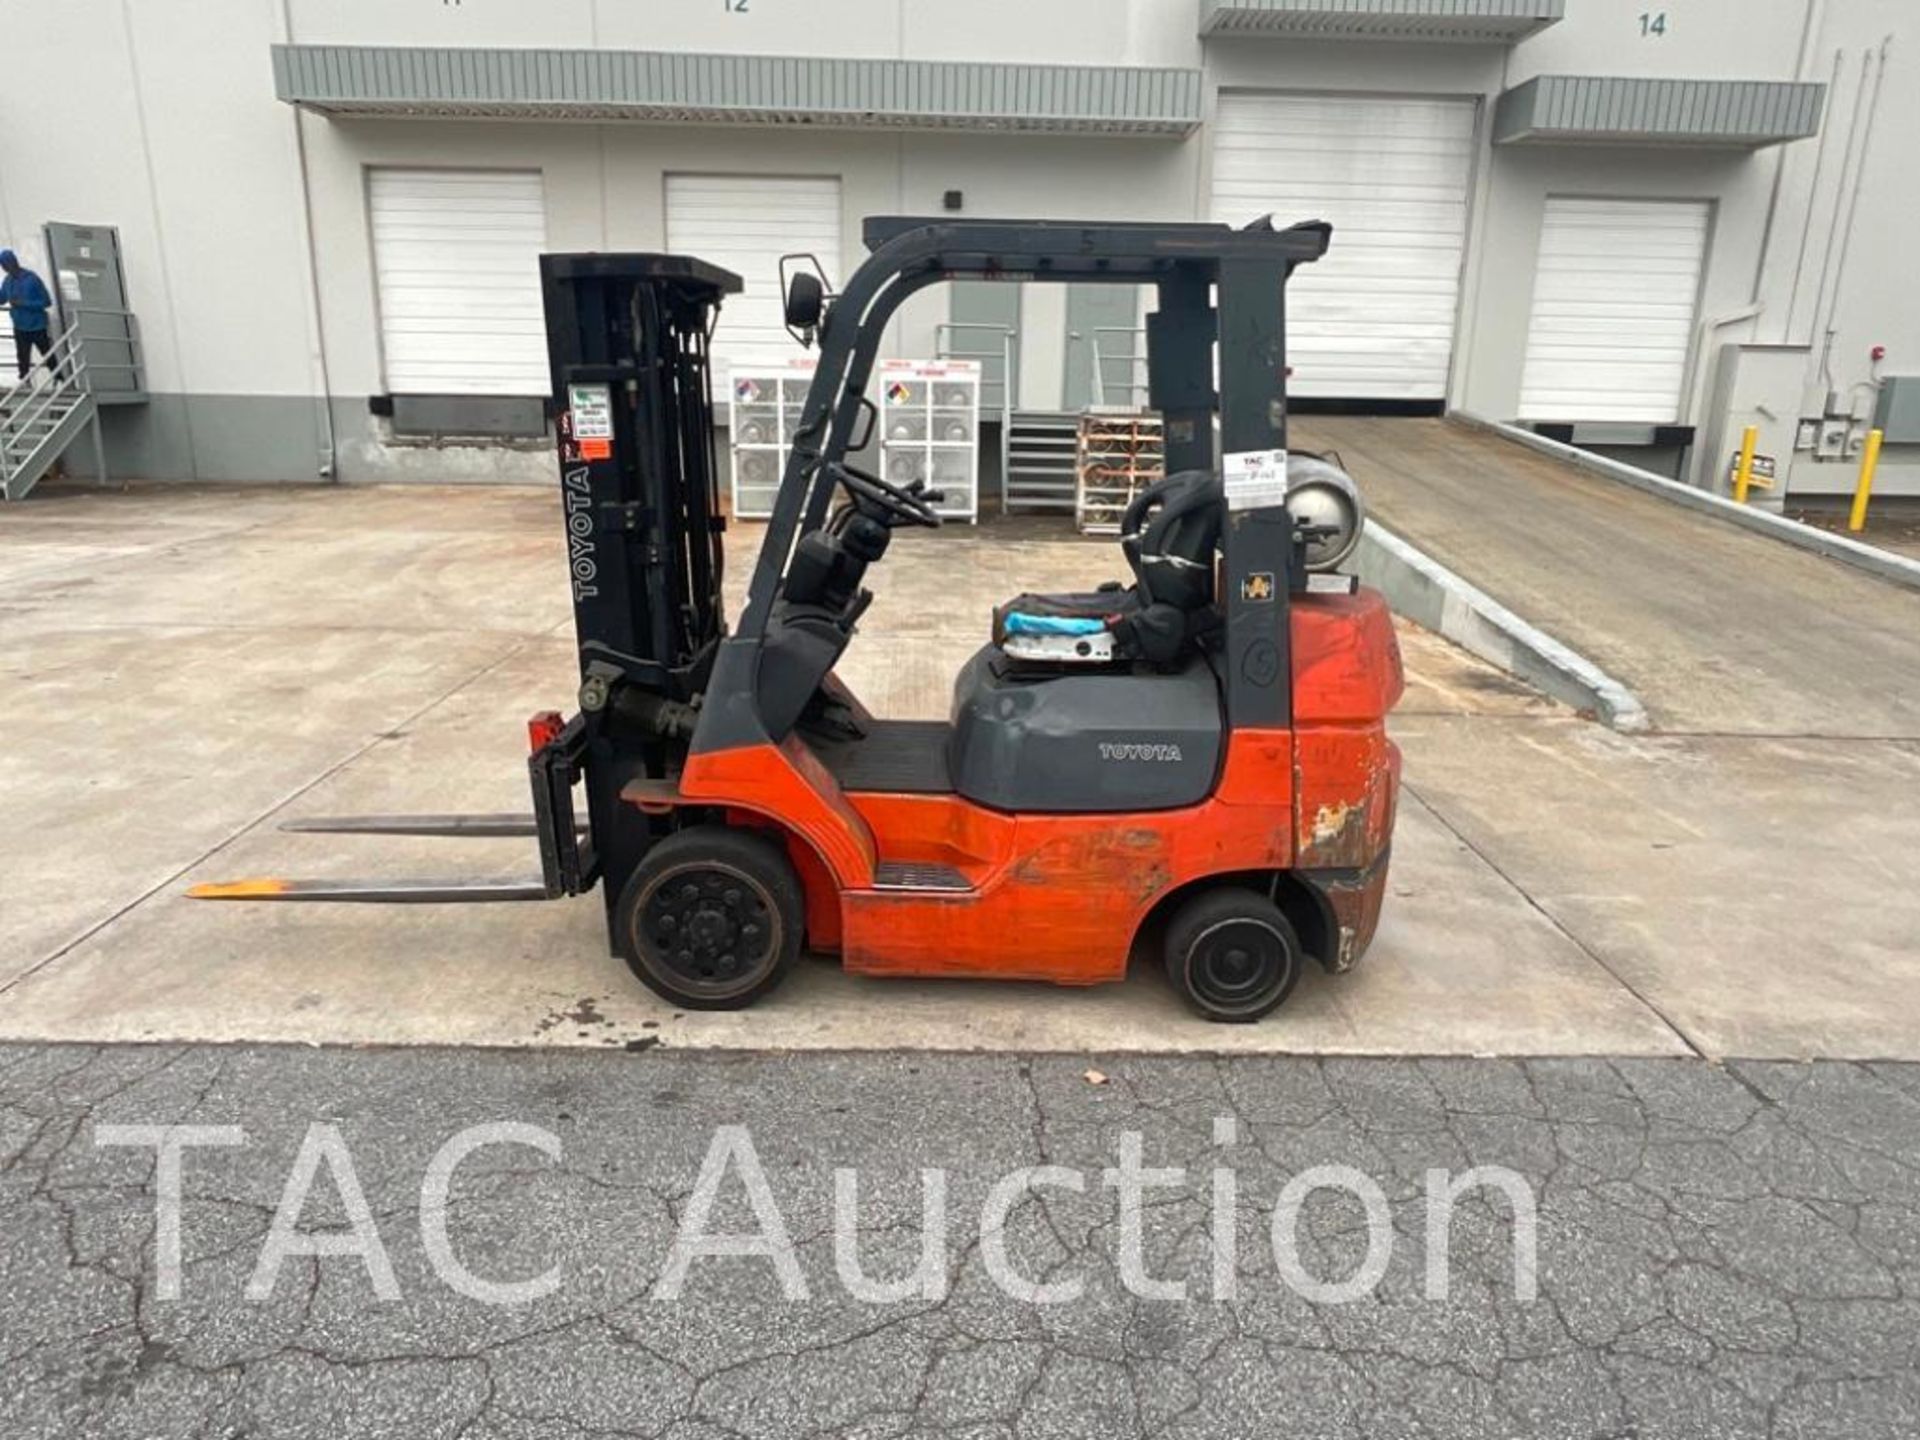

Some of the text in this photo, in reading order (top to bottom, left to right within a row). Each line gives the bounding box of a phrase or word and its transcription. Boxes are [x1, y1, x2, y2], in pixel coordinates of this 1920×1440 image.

[1638, 12, 1667, 37] 14
[565, 466, 599, 602] TOYOTA
[1098, 743, 1182, 761] TOYOTA
